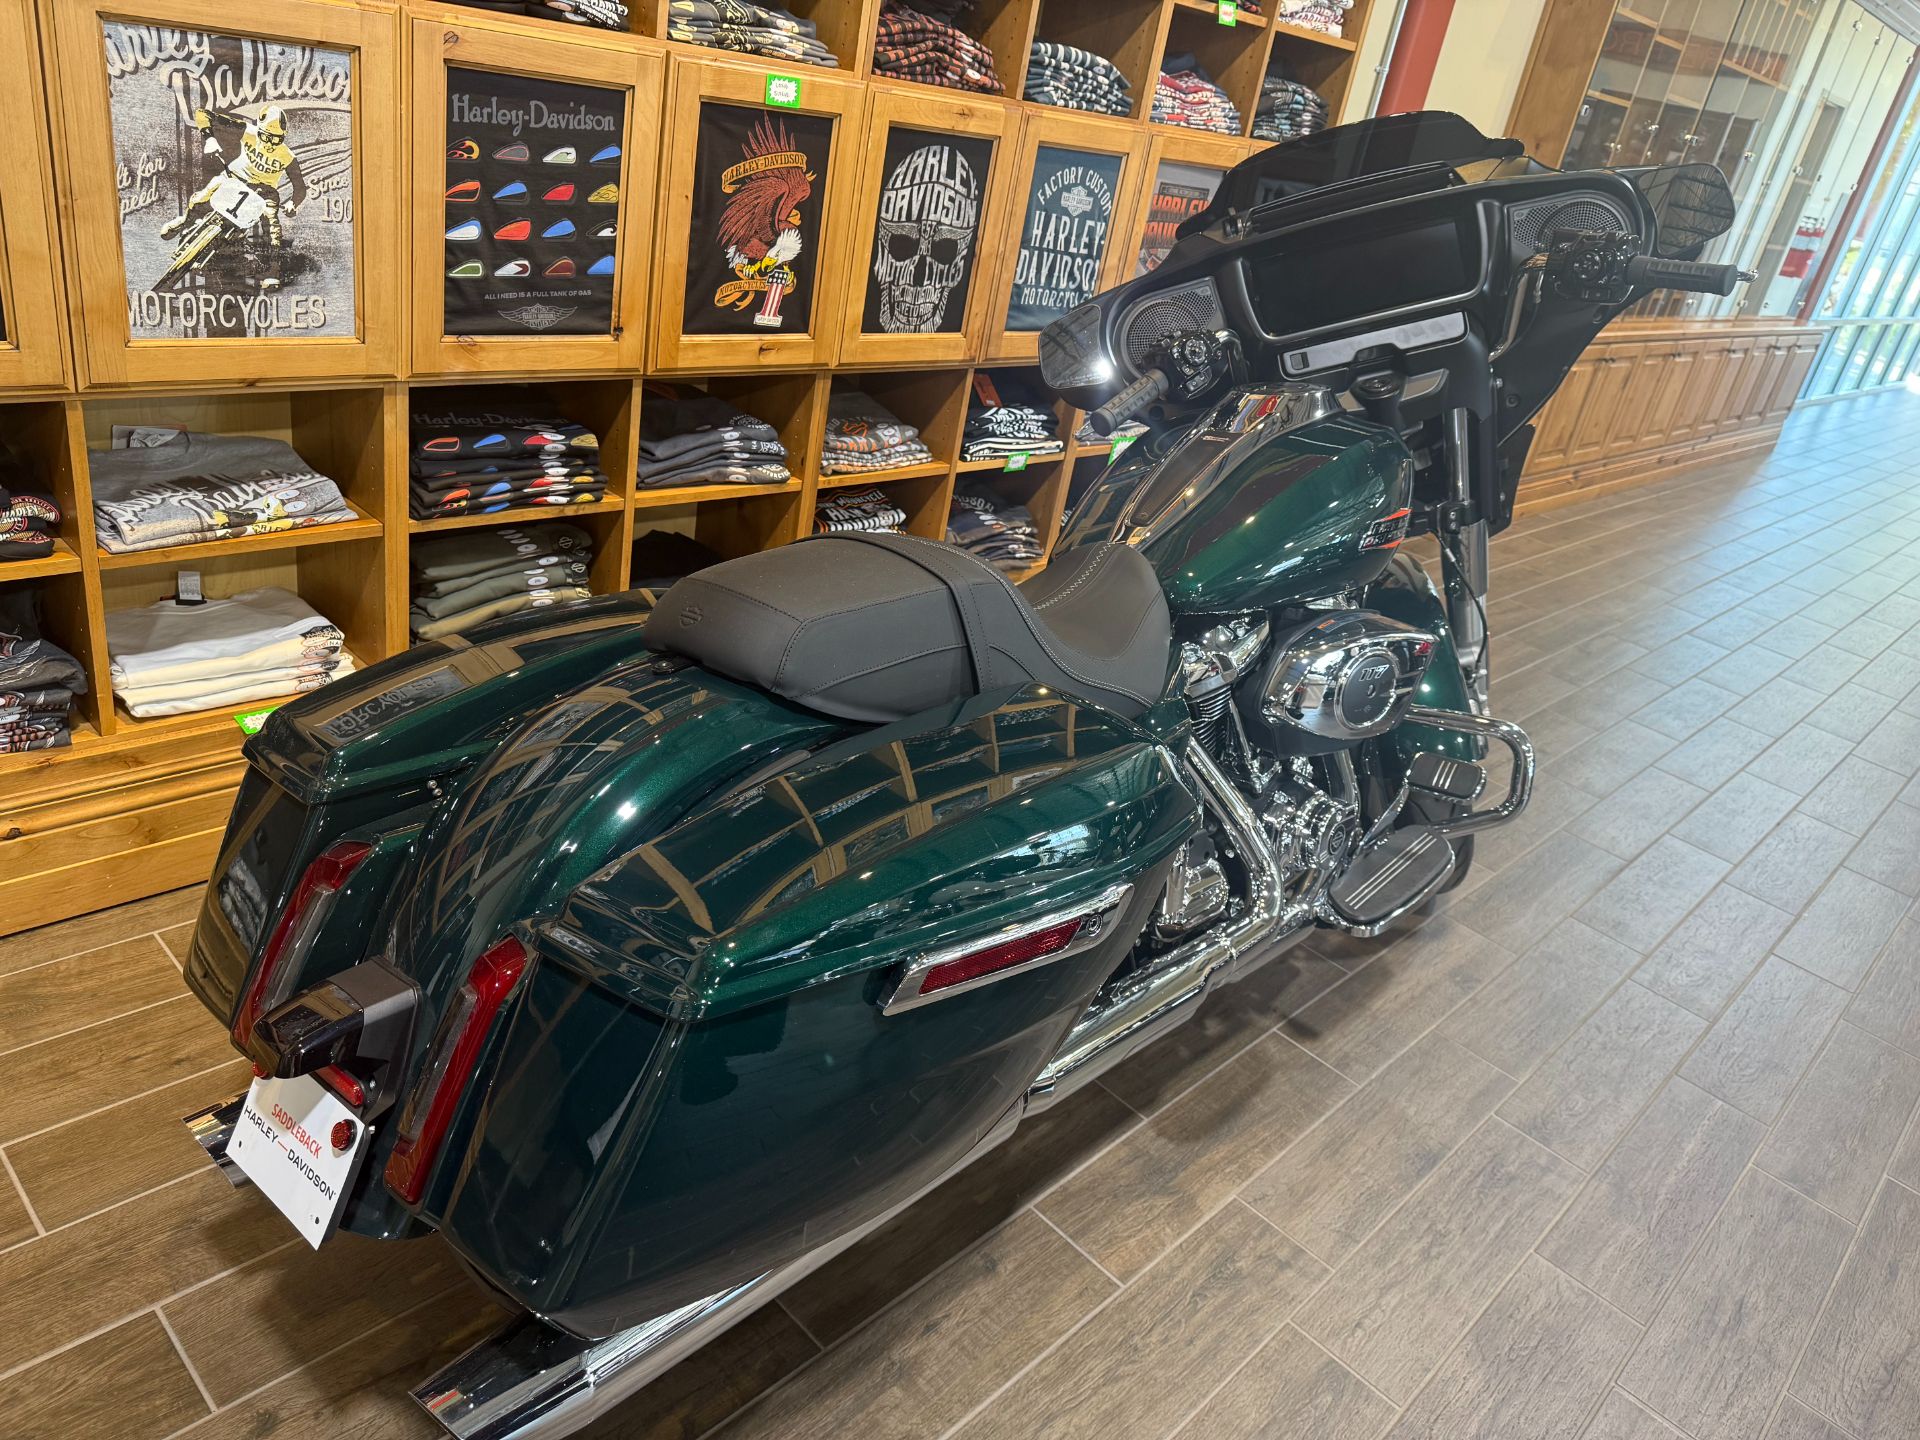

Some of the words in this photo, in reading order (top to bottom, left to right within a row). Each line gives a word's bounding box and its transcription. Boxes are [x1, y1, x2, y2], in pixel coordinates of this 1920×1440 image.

[451, 93, 616, 137] Harley-Davidson
[120, 176, 160, 219] peed
[225, 190, 250, 219] 1
[307, 176, 351, 200] Since
[880, 182, 978, 231] DAVIDSON
[1037, 166, 1083, 205] FACTORY
[1085, 170, 1113, 216] CUSTOM
[126, 290, 327, 330] MOTORCYCLES
[1359, 664, 1390, 682] 117
[271, 1103, 323, 1160] SADDLEBACK
